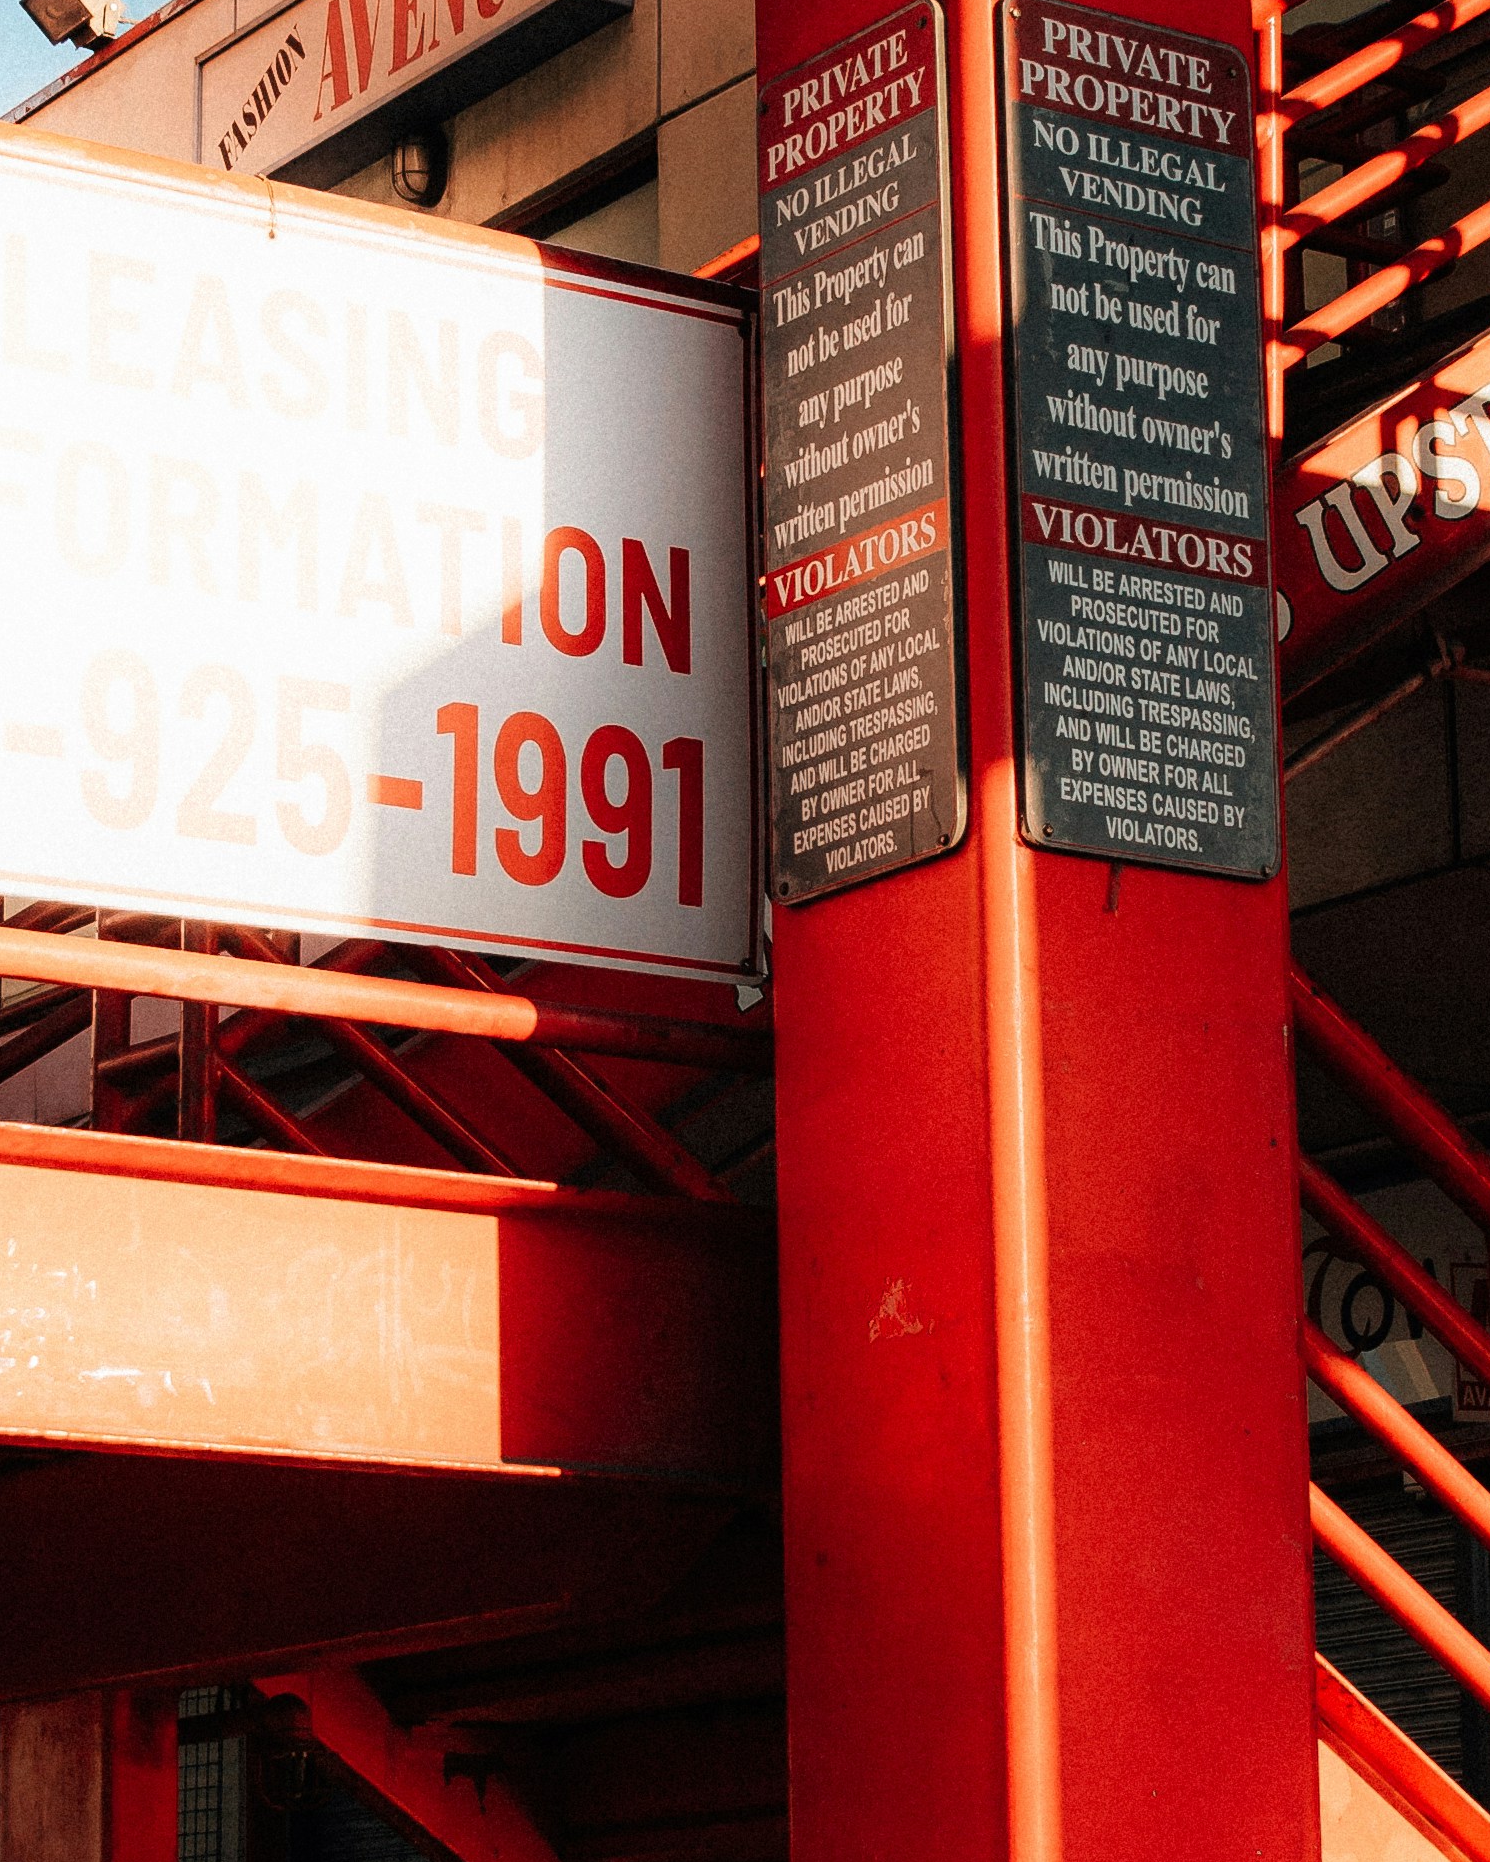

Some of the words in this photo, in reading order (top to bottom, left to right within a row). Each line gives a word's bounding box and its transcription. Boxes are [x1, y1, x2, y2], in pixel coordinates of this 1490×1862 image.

[783, 29, 908, 128] PRIVATE
[1041, 16, 1212, 92] PRIVATE
[217, 24, 308, 171] FASHION
[767, 66, 925, 182] PROPERTY
[1019, 58, 1236, 145] PROPERTY
[776, 187, 809, 226] NO
[814, 133, 917, 208] ILLEGAL
[1032, 118, 1079, 156] NO
[1086, 132, 1226, 193] ILLEGAL
[794, 181, 900, 255] VENDING
[1058, 167, 1203, 227] VENDING
[773, 281, 810, 327] This
[814, 246, 889, 309] Property
[893, 231, 925, 269] can
[1029, 211, 1082, 259] This
[1087, 223, 1189, 293] Property
[1195, 261, 1236, 294] can
[1, 232, 544, 462] LEASING
[787, 333, 815, 378] not
[818, 326, 839, 362] be
[842, 299, 881, 351] used
[885, 292, 912, 331] for
[1050, 282, 1089, 315] not
[1094, 285, 1123, 325] be
[1128, 300, 1181, 341] used
[1186, 304, 1221, 345] for
[799, 389, 829, 429] any
[833, 356, 903, 423] purpose
[1067, 342, 1110, 386] any
[1115, 358, 1209, 401] purpose
[784, 430, 849, 489] without
[852, 398, 920, 459] owner's
[1046, 389, 1137, 440] without
[1142, 403, 1232, 460] owner's
[774, 501, 835, 549] written
[839, 457, 933, 534] permission
[1032, 445, 1118, 493] written
[1123, 468, 1249, 519] permission
[773, 511, 936, 608] VIOLATORS
[1031, 502, 1253, 578] VIOLATORS
[785, 616, 814, 647] WILL
[816, 607, 833, 633] BE
[835, 586, 900, 627] ARRESTED
[902, 569, 929, 600] AND
[1048, 559, 1088, 588] WILL
[1092, 568, 1114, 594] BE
[1118, 574, 1205, 611] ARRESTED
[1209, 591, 1243, 618] AND
[1071, 594, 1181, 636] PROSECUTED
[1186, 616, 1220, 643] FOR
[777, 663, 848, 709] VIOLATIONS
[850, 655, 867, 679] OF
[869, 645, 895, 674] ANY
[898, 628, 940, 663] LOCAL
[801, 619, 881, 670] PROSECUTED
[884, 607, 910, 637] FOR
[1037, 618, 1135, 659] VIOLATIONS
[1140, 638, 1161, 662] OF
[1166, 643, 1200, 670] ANY
[1203, 650, 1258, 680] LOCAL
[795, 696, 841, 733] AND/OR
[843, 680, 881, 715] STATE
[884, 666, 922, 699] LAWS,
[1044, 681, 1134, 719] INCLUDING
[1138, 699, 1256, 743] TRESPASSING,
[1062, 655, 1126, 687] AND/OR
[1131, 667, 1181, 697] STATE
[1186, 677, 1236, 710] LAWS,
[782, 724, 847, 768] INCLUDING
[849, 690, 938, 740] TRESPASSING,
[790, 767, 816, 795] AND
[818, 755, 849, 785] WILL
[850, 747, 867, 774] BE
[869, 724, 931, 765] CHARGED
[1056, 715, 1091, 742] AND
[1095, 721, 1135, 749] WILL
[1139, 730, 1161, 754] BE
[1166, 734, 1246, 768] CHARGED
[801, 795, 818, 822] BY
[820, 779, 865, 814] OWNER
[868, 768, 894, 797] FOR
[896, 759, 921, 788] ALL
[1060, 777, 1148, 813] EXPENSES
[1152, 792, 1219, 823] CAUSED
[1223, 805, 1246, 829] BY
[1071, 748, 1094, 773] BY
[1099, 753, 1160, 785] OWNER
[1164, 764, 1198, 791] FOR
[1202, 770, 1233, 797] ALL
[793, 813, 857, 855] EXPENSES
[859, 793, 910, 831] CAUSED
[913, 785, 930, 813] BY
[825, 830, 898, 874] VIOLATORS.
[1106, 815, 1203, 852] VIOLATORS.
